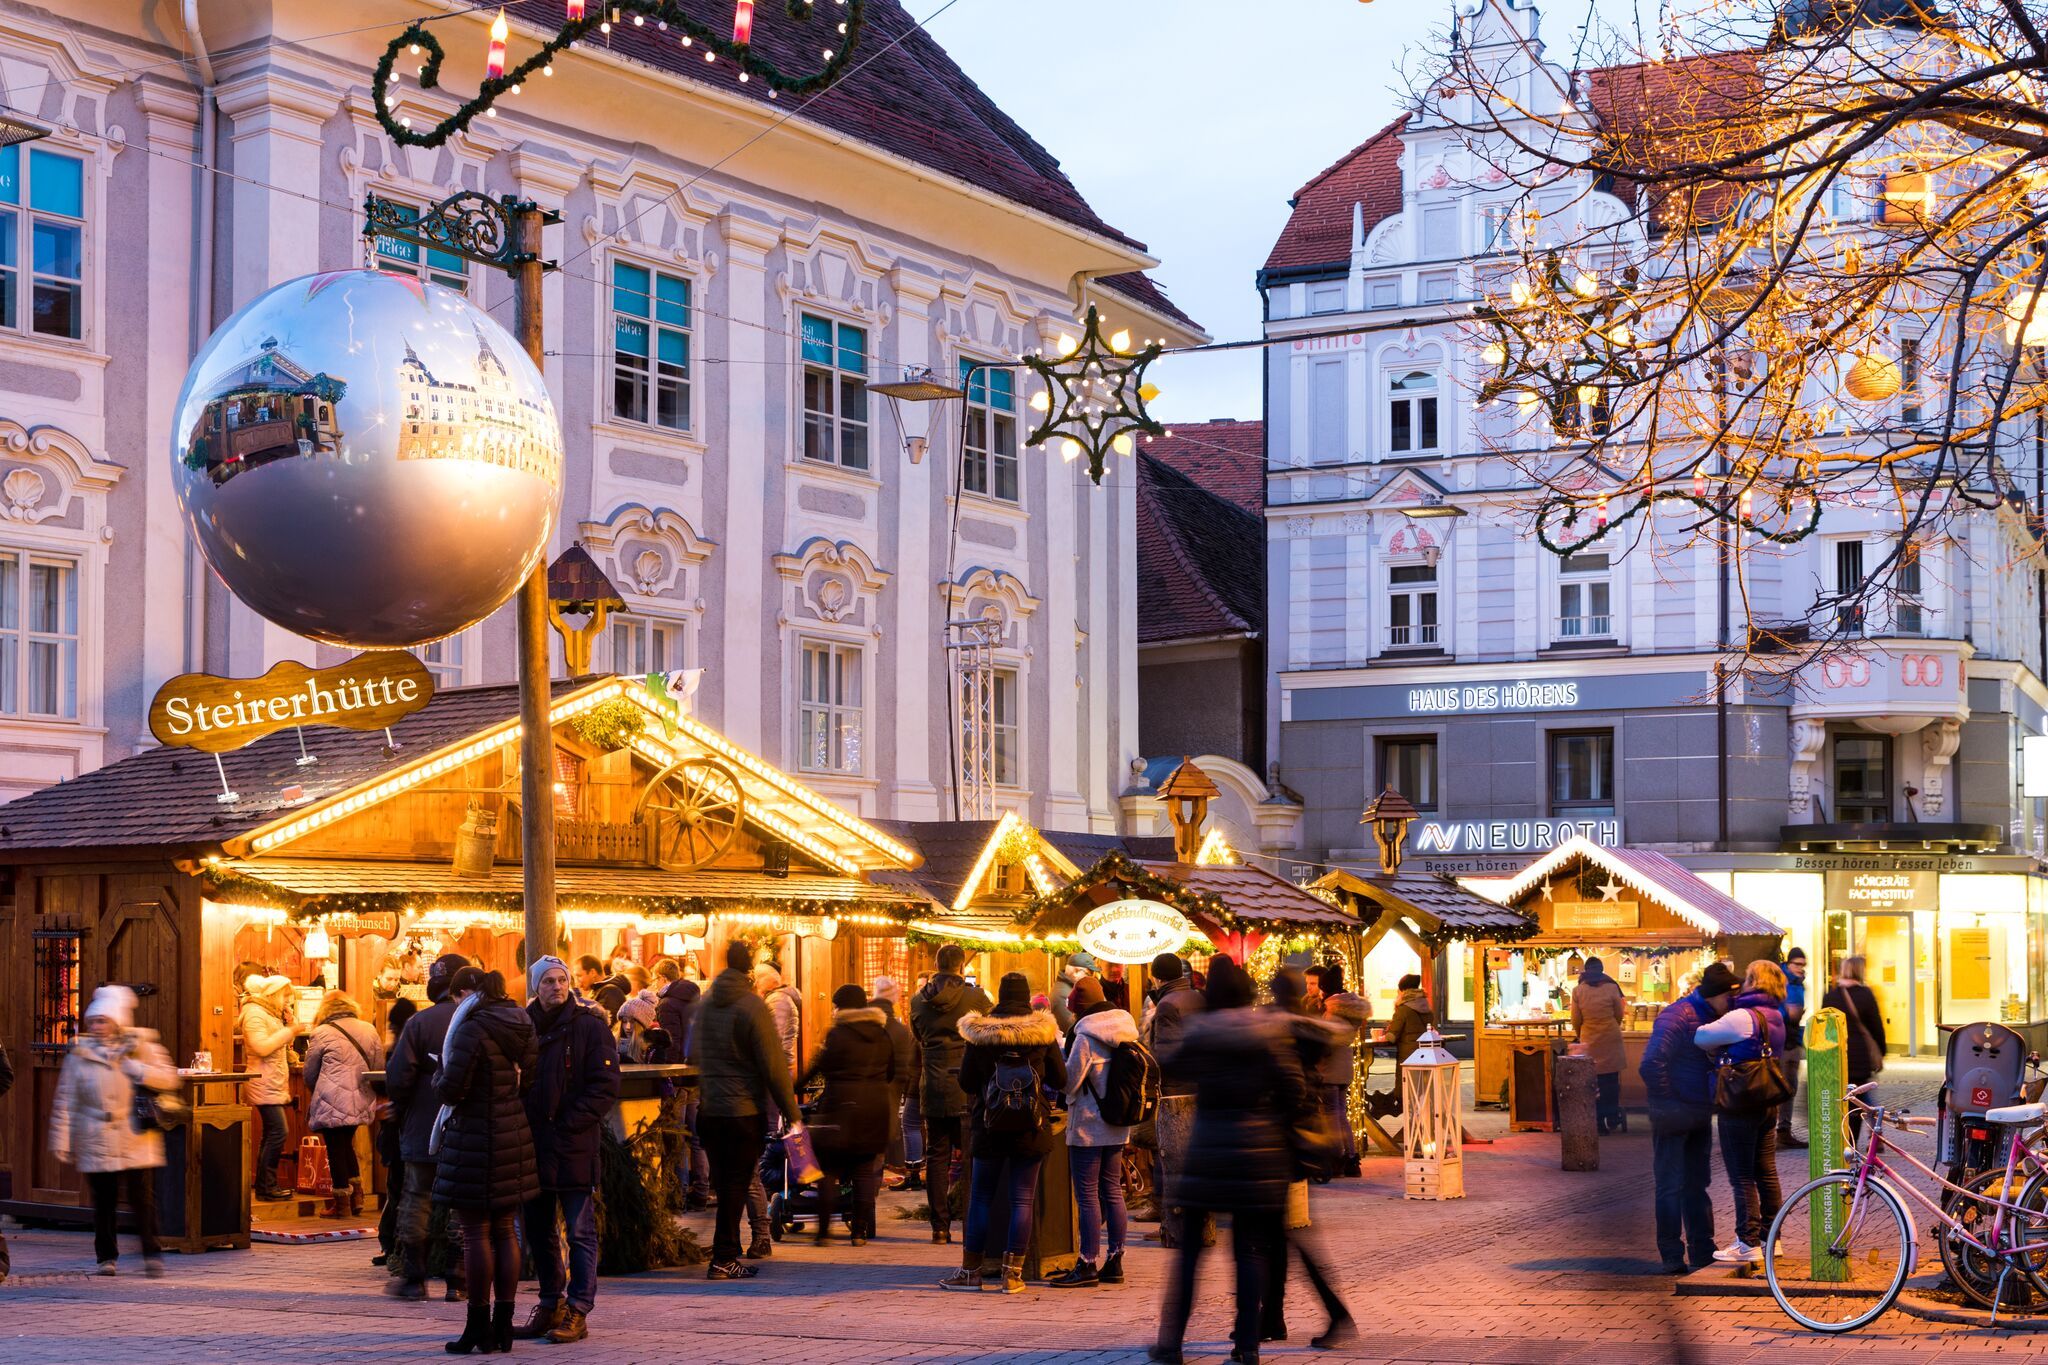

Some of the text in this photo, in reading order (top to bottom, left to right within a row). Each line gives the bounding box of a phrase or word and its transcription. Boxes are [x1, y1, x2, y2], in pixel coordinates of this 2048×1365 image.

[165, 676, 419, 735] Steirerhütte
[1410, 681, 1578, 711] HAUS DES HÖRENS
[1466, 820, 1619, 849] NEUROTH
[1425, 861, 1470, 872] Besser
[1476, 859, 1518, 871] hören
[1795, 857, 1838, 869] Besser
[1842, 857, 1880, 869] hören
[1938, 858, 1973, 870] leben
[1854, 874, 1910, 887] HÖRGERÄTE
[1849, 889, 1915, 900] FACHINSTITUT
[329, 915, 390, 931] Apfelpunsch
[1821, 1089, 1830, 1122] BETRIEB
[1822, 1124, 1831, 1157] AUSSER
